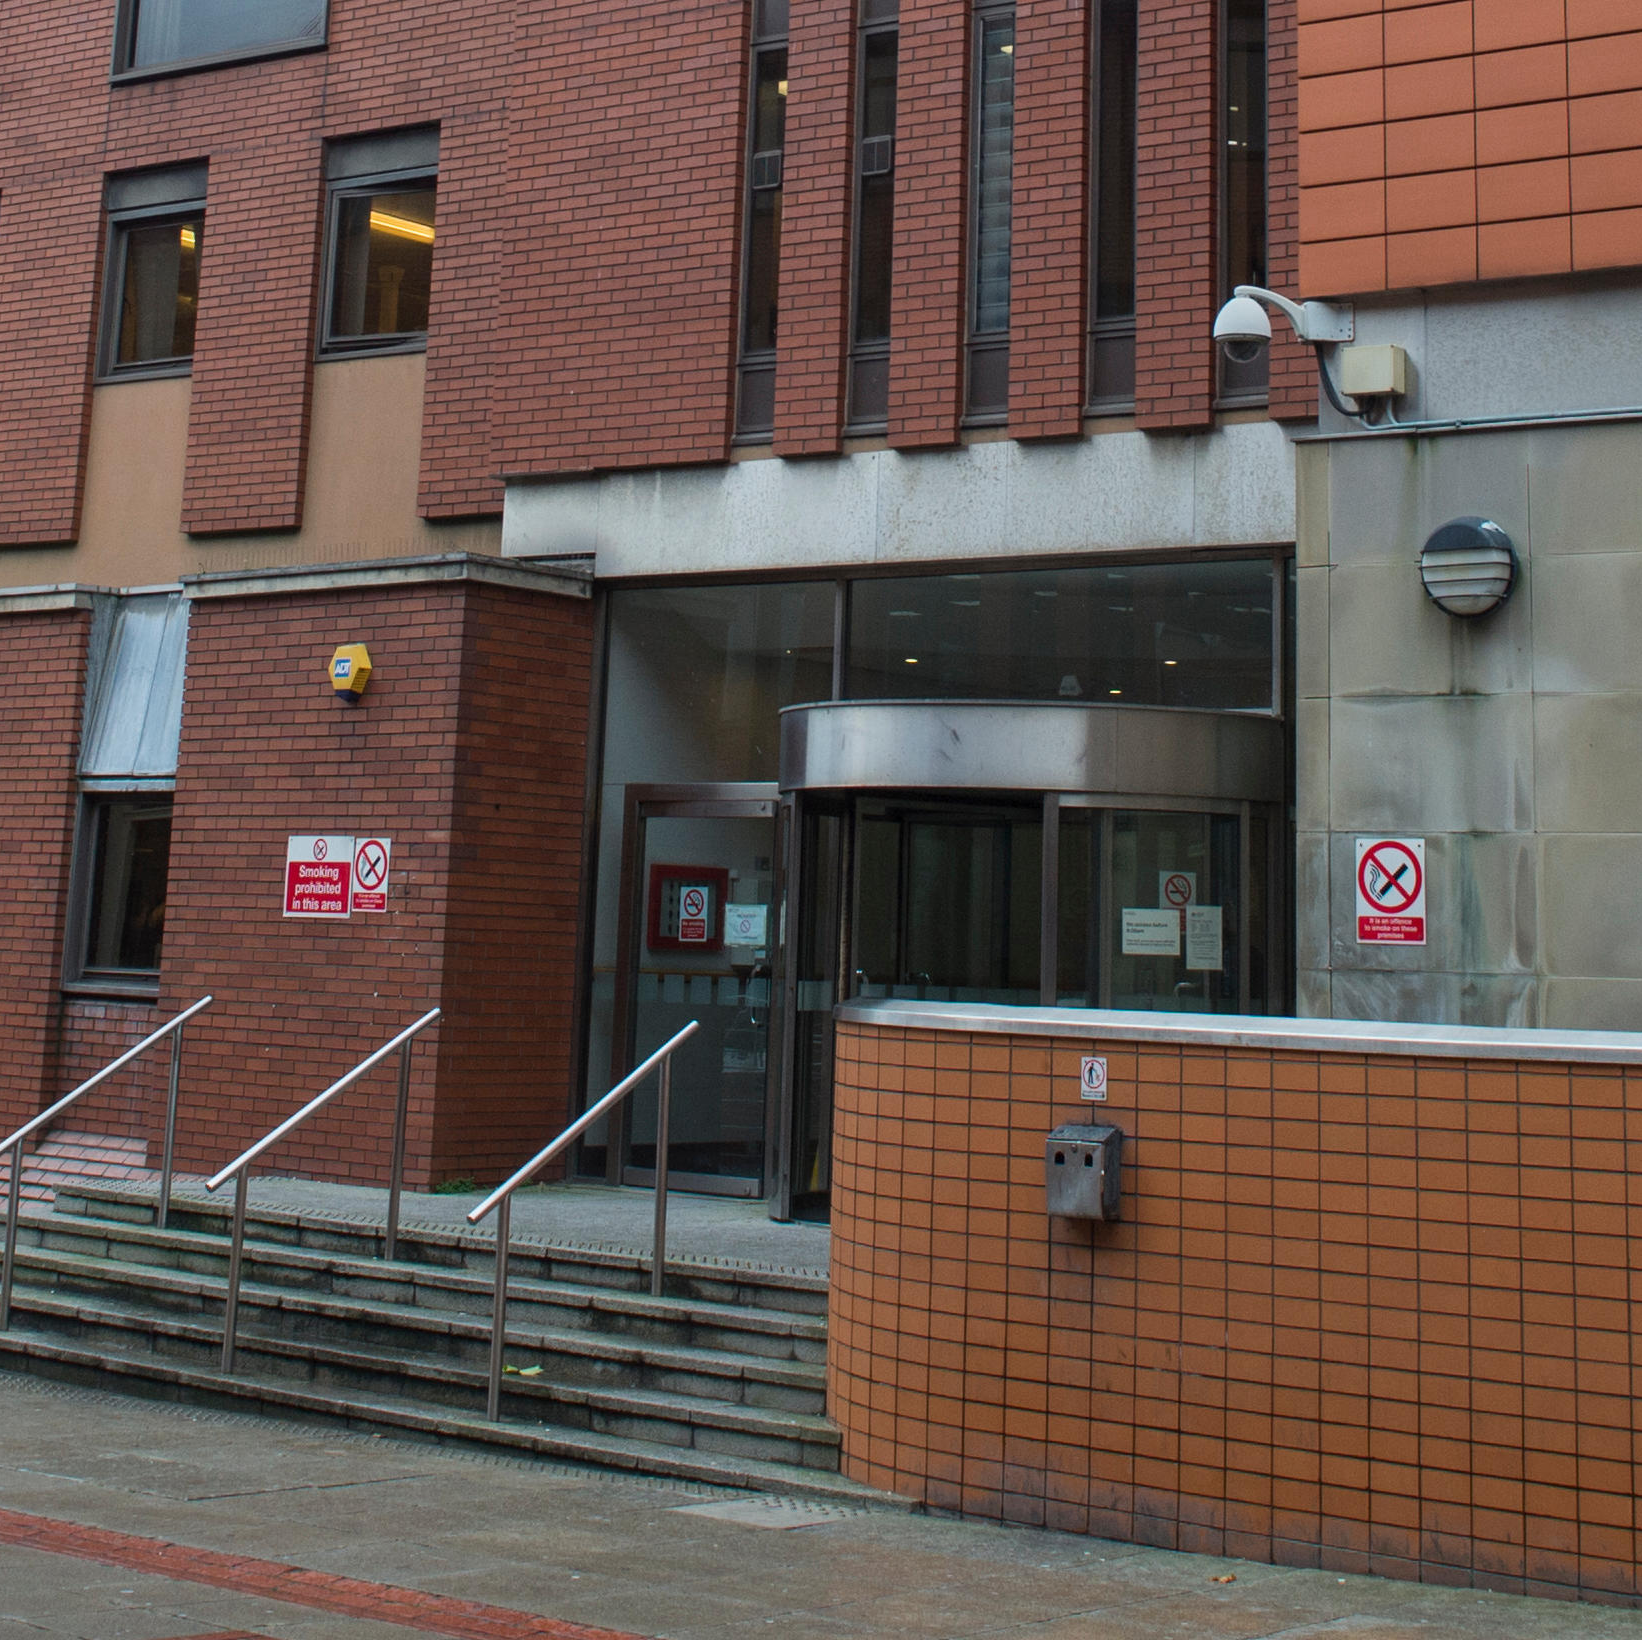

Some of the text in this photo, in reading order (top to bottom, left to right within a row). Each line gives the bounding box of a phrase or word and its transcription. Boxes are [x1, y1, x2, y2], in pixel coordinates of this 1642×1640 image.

[334, 662, 350, 674] ADT
[299, 864, 339, 881] Smoking
[294, 881, 342, 896] prohibited
[292, 897, 301, 910] in
[302, 898, 319, 910] this
[320, 900, 342, 911] area
